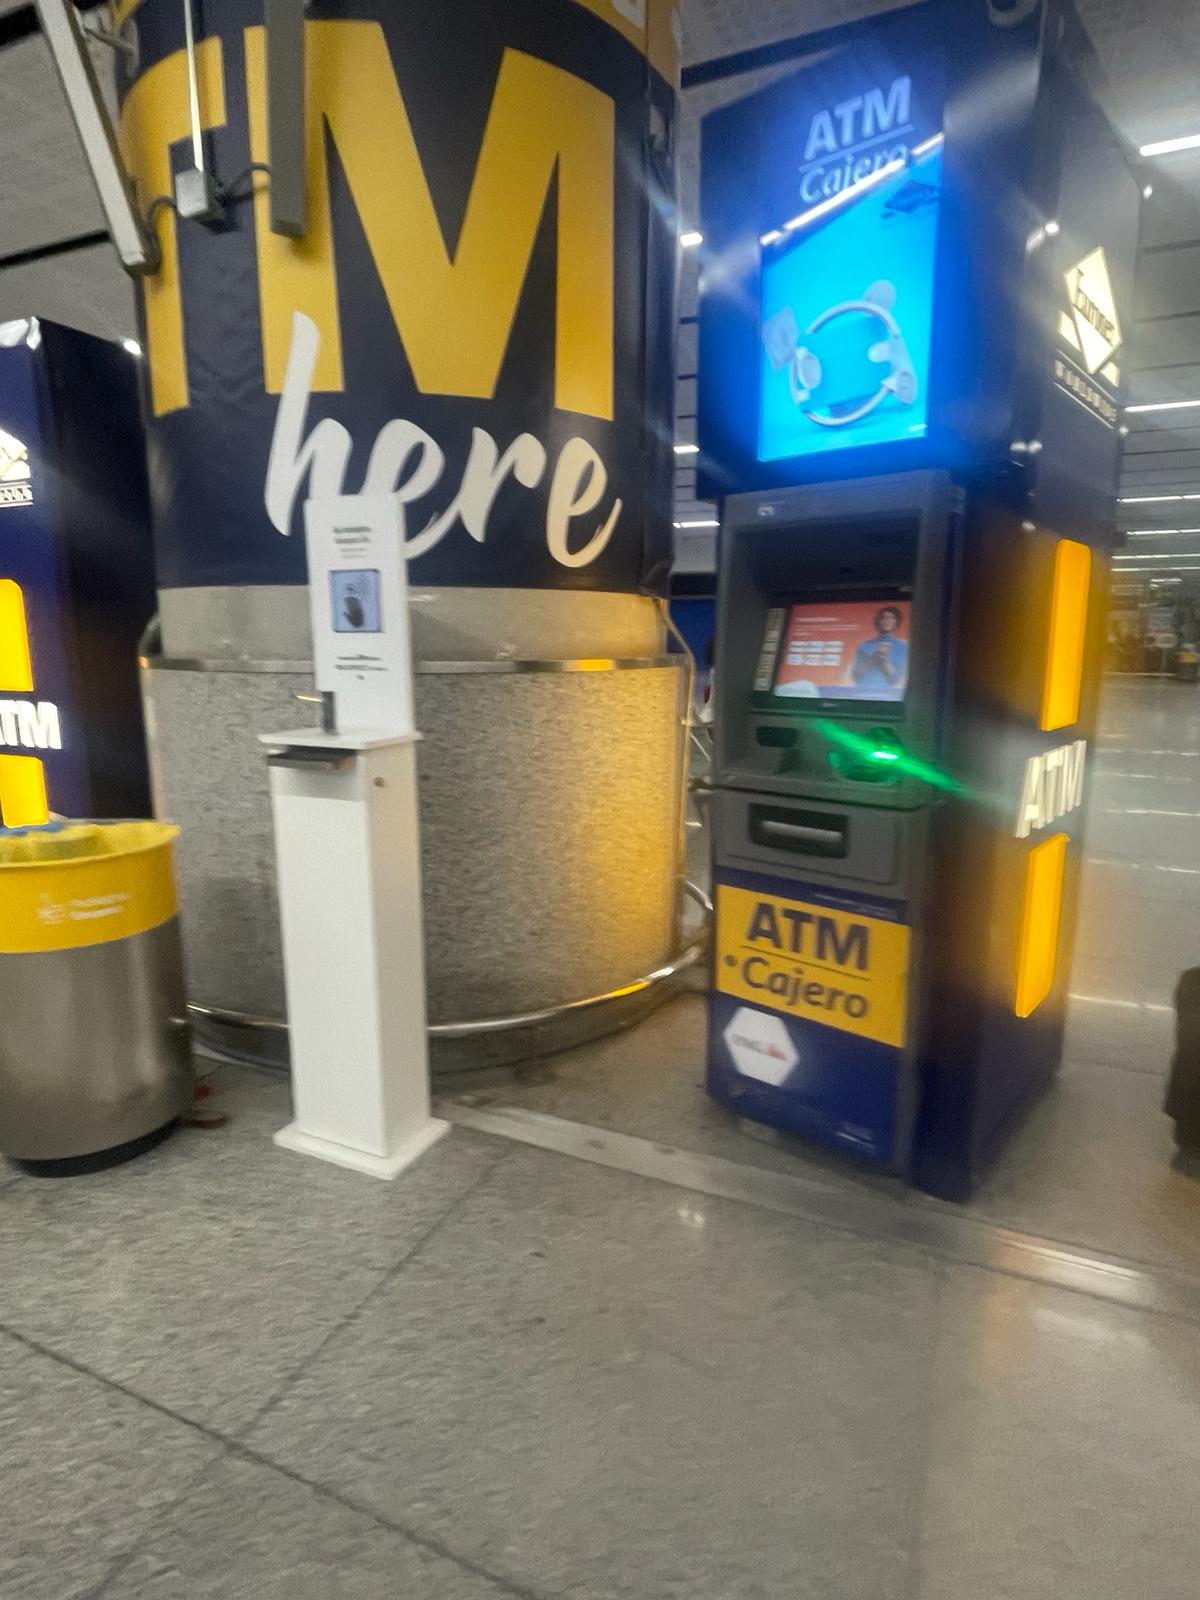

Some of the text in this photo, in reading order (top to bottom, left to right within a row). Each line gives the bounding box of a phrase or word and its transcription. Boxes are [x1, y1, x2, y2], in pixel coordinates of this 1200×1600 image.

[803, 75, 912, 161] ATM
[264, 311, 623, 568] here
[0, 699, 62, 750] TM
[1015, 740, 1087, 838] ATM
[746, 902, 871, 972] ATM
[742, 956, 869, 1019] Cajero
